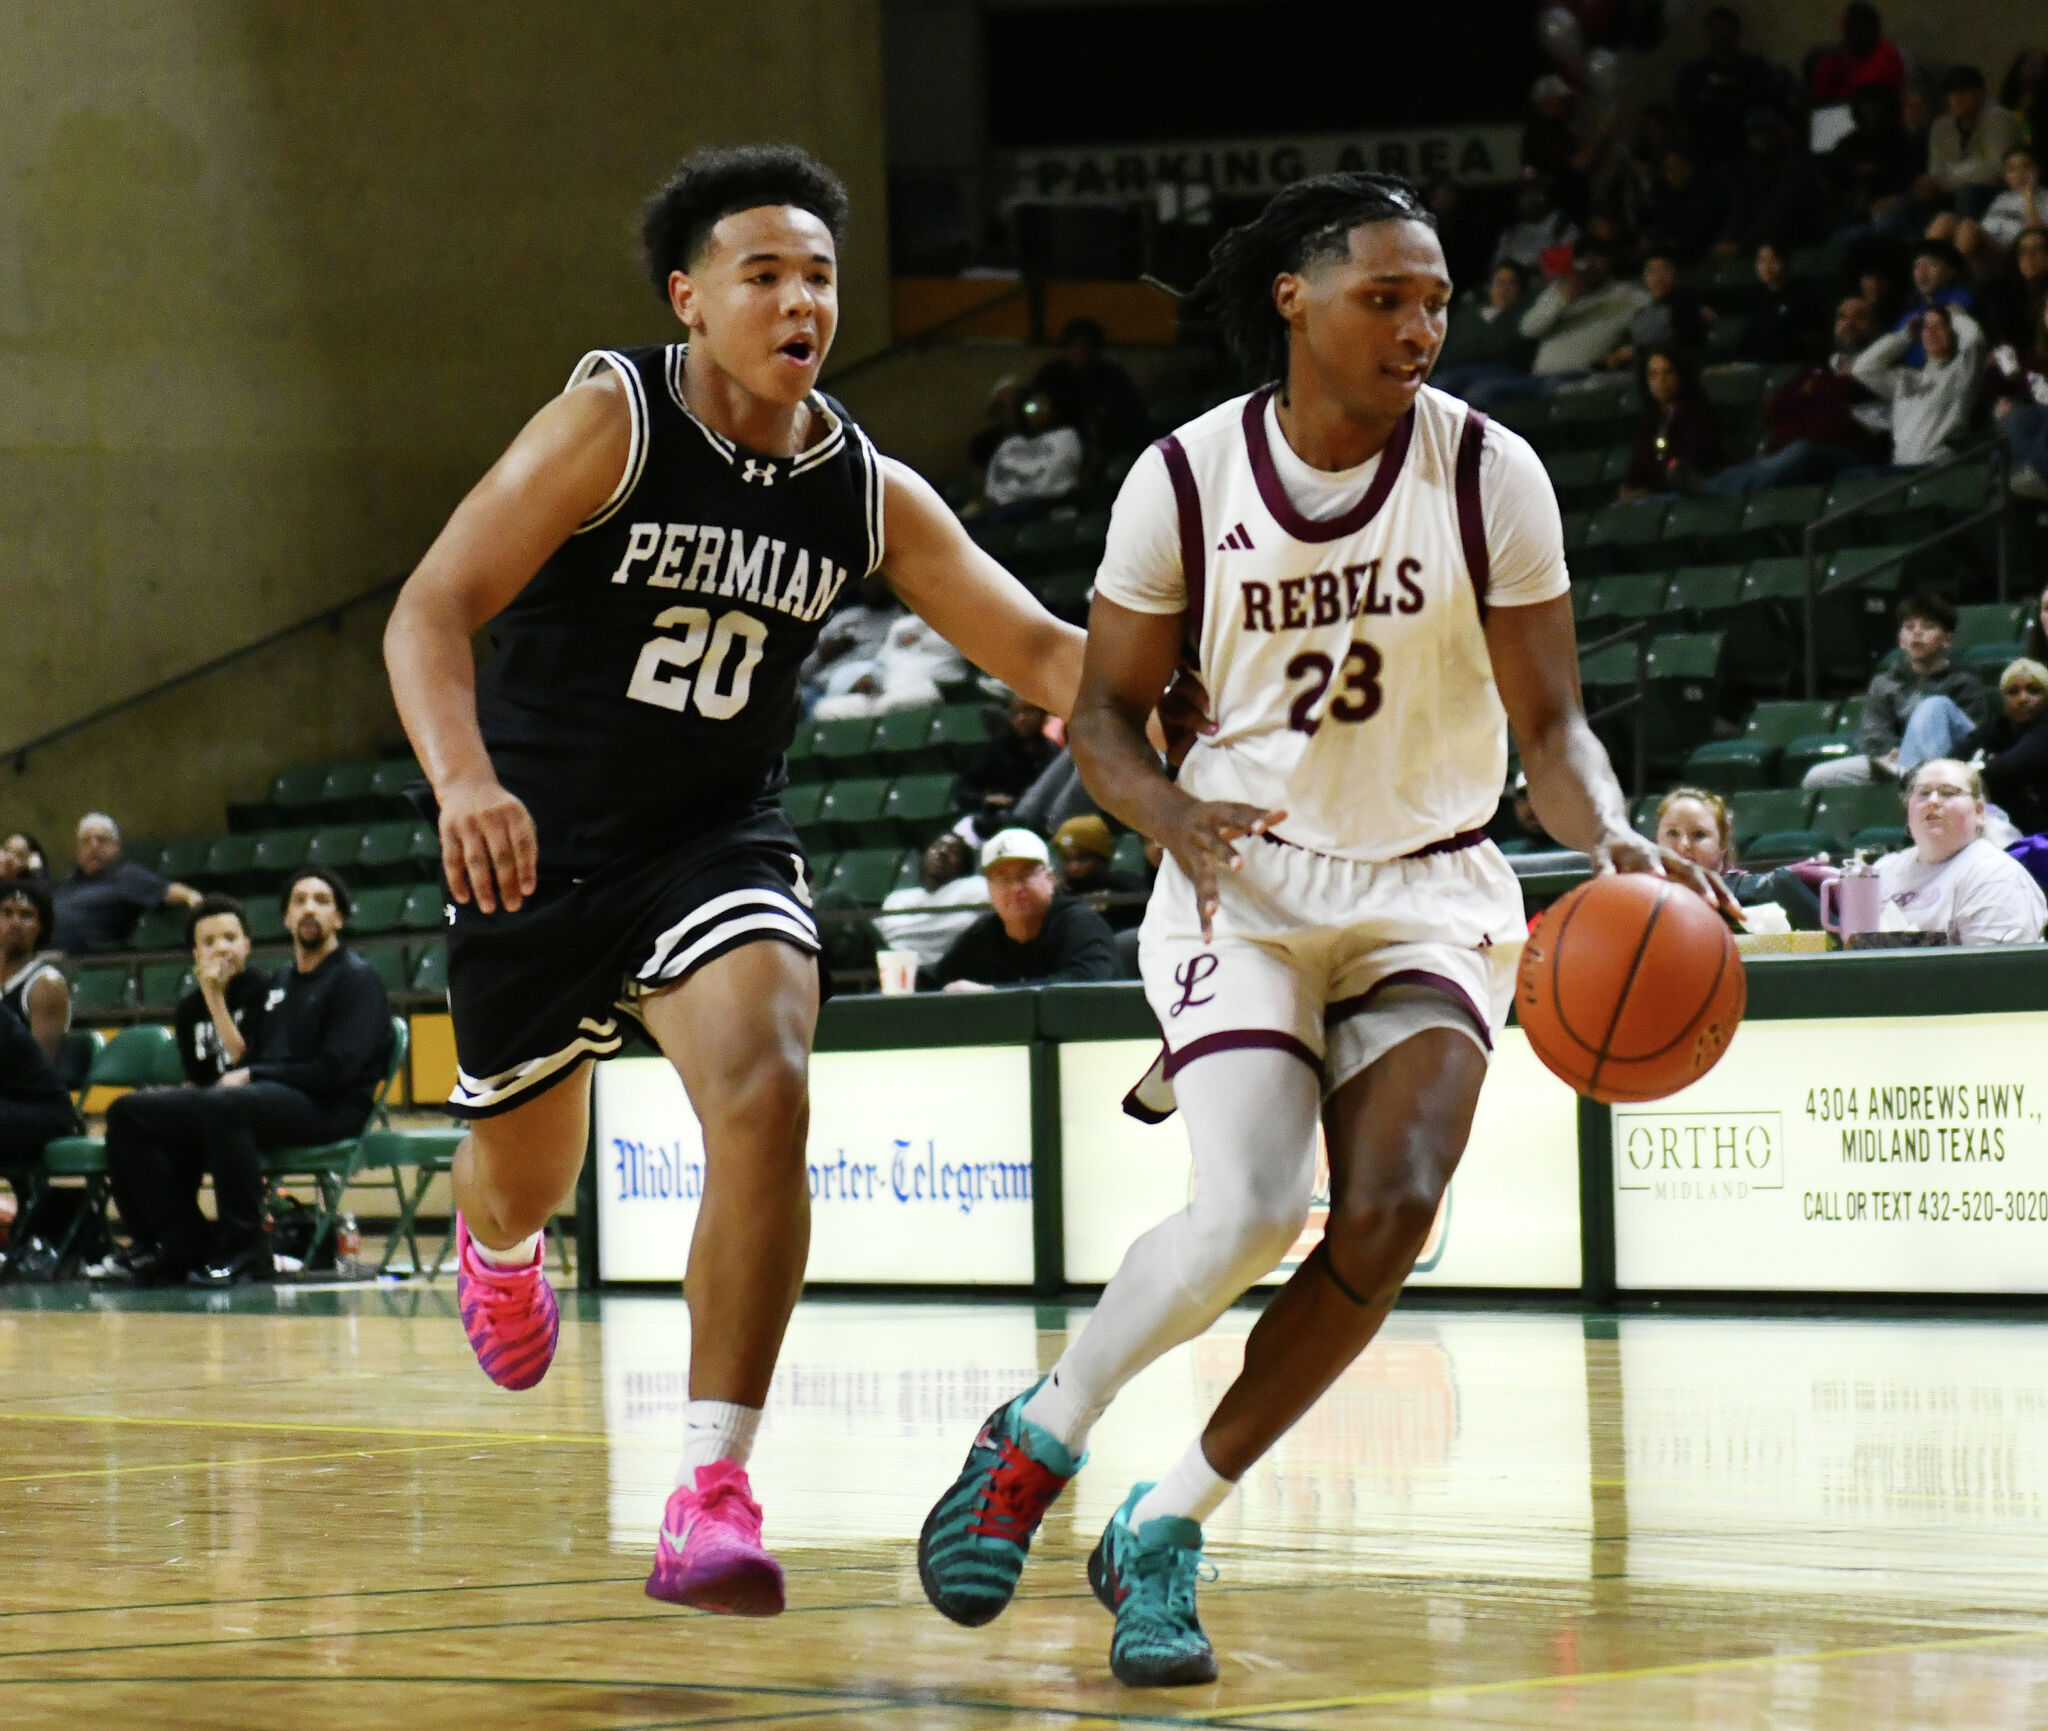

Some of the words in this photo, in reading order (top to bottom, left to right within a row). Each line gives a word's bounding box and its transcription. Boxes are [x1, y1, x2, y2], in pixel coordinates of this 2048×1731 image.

[1036, 145, 1307, 195] PARKING
[1335, 136, 1494, 177] AREA
[610, 522, 848, 622] PERMIAN
[1241, 557, 1425, 633] REBELS
[625, 605, 769, 721] 20
[1285, 641, 1384, 738] 23
[1170, 953, 1218, 1018] L
[1804, 1087, 1859, 1122] 4304
[1868, 1085, 1970, 1121] ANDREWS
[613, 1137, 704, 1201] Midla
[807, 1138, 1033, 1215] orter-Telegram
[1628, 1125, 1771, 1170] ORTHO
[1841, 1128, 1931, 1163] MIDLAND
[1938, 1127, 2006, 1163] TEXAS
[1654, 1180, 1749, 1200] MIDLAND
[1803, 1191, 1843, 1221] CALL
[1847, 1192, 1868, 1221] OR
[1872, 1191, 1912, 1221] TEXT
[1918, 1190, 2048, 1222] 432-520-3020
